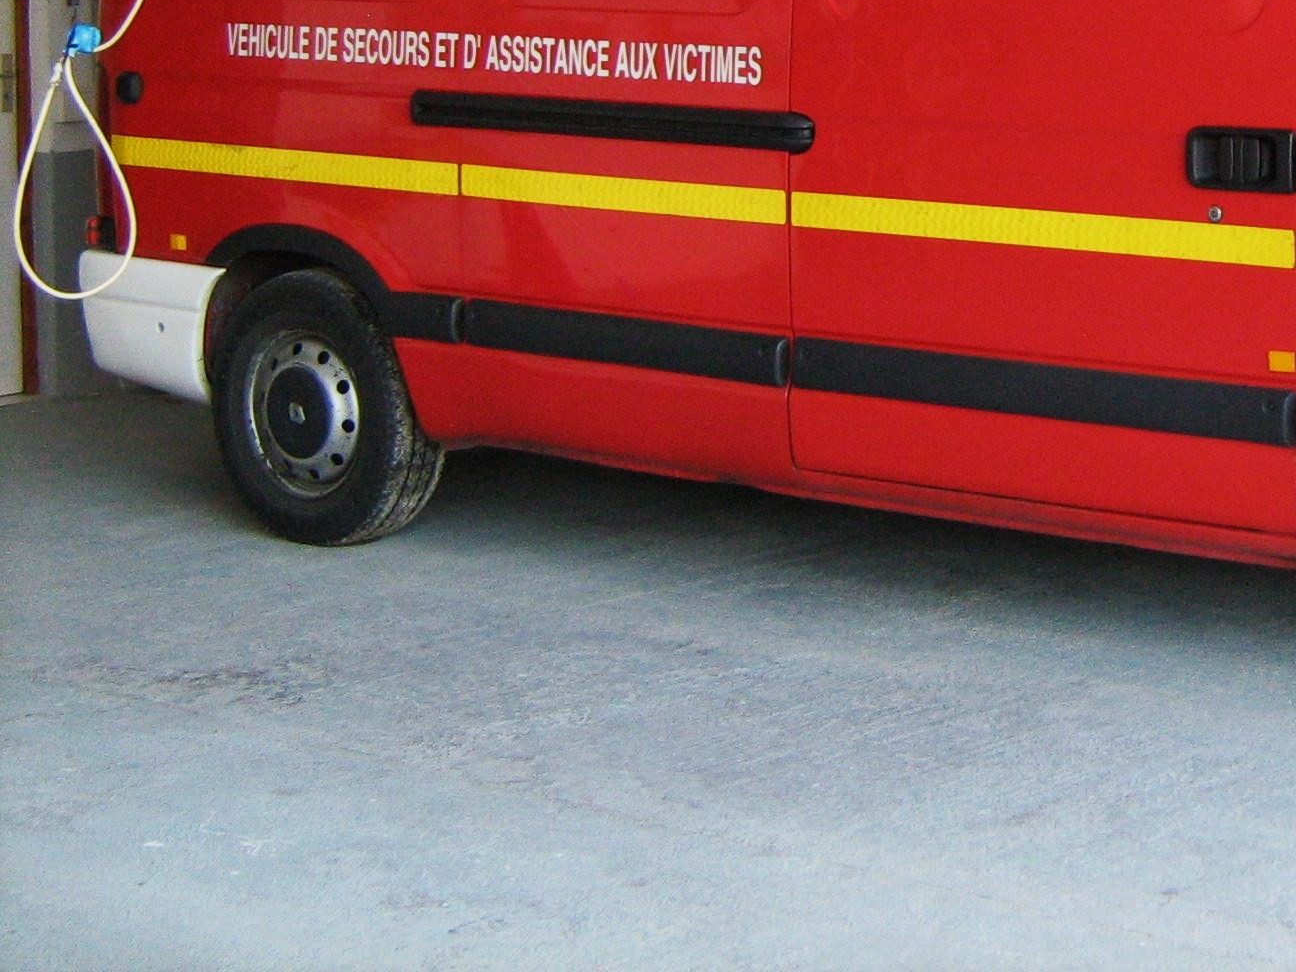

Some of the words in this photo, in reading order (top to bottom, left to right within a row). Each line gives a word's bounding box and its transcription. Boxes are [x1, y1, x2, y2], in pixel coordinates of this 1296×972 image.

[227, 23, 310, 60] VEHICULE
[314, 26, 339, 62] DE
[342, 27, 430, 68] SECOURS
[434, 31, 460, 68] ET
[463, 32, 482, 69] D'
[485, 34, 610, 78] ASSISTANCE
[614, 41, 658, 80] AUX
[663, 43, 762, 86] VICTIMES
